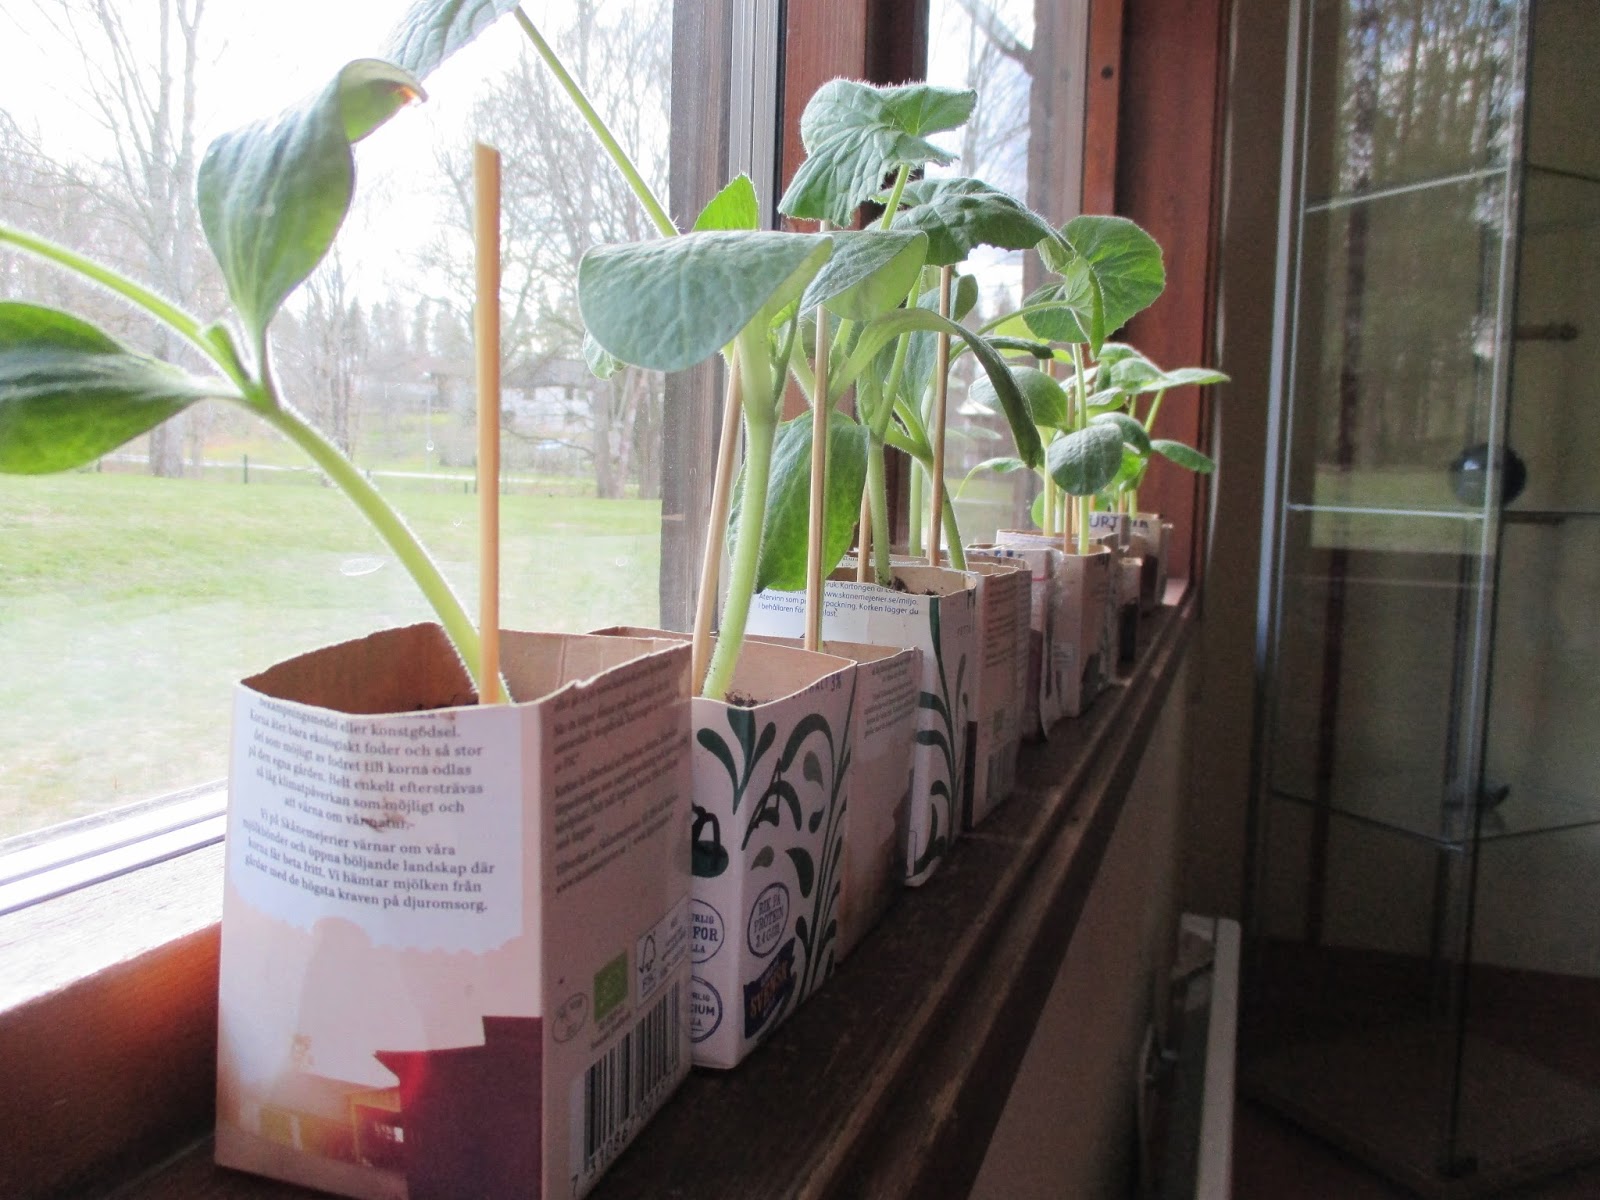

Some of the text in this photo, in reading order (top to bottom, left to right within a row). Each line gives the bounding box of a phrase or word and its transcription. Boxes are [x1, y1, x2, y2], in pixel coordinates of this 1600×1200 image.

[840, 582, 876, 592] Kartongen
[859, 603, 883, 612] Korken
[909, 607, 918, 615] du
[341, 721, 366, 735] eller
[371, 724, 460, 740] konstgödsel.
[364, 742, 400, 755] foder
[405, 744, 430, 757] och
[435, 743, 450, 757] så
[454, 746, 482, 757] stor
[364, 761, 384, 773] till
[388, 762, 428, 775] korna
[432, 763, 472, 776] odlas
[354, 779, 394, 793] enkelt
[399, 781, 483, 795] eftersträvas
[354, 799, 380, 810] som
[384, 798, 434, 816] möjligt
[438, 800, 465, 813] och
[326, 811, 342, 823] om
[281, 818, 348, 848] Skånemejerier
[353, 838, 395, 853] värnar
[399, 844, 421, 854] om
[426, 843, 456, 856] våra
[290, 840, 306, 853] och
[308, 845, 340, 864] öppna
[343, 853, 399, 872] böljande
[403, 860, 466, 877] landskap
[471, 861, 495, 874] där
[283, 853, 301, 870] beta
[328, 867, 340, 881] Vi
[343, 870, 389, 888] hämtar
[393, 879, 448, 892] mjölken
[453, 880, 482, 893] från
[270, 867, 287, 881] med
[289, 873, 299, 886] de
[302, 877, 335, 897] högsta
[338, 887, 379, 905] kraven
[383, 895, 399, 909] på
[403, 895, 488, 914] djuromsorg.
